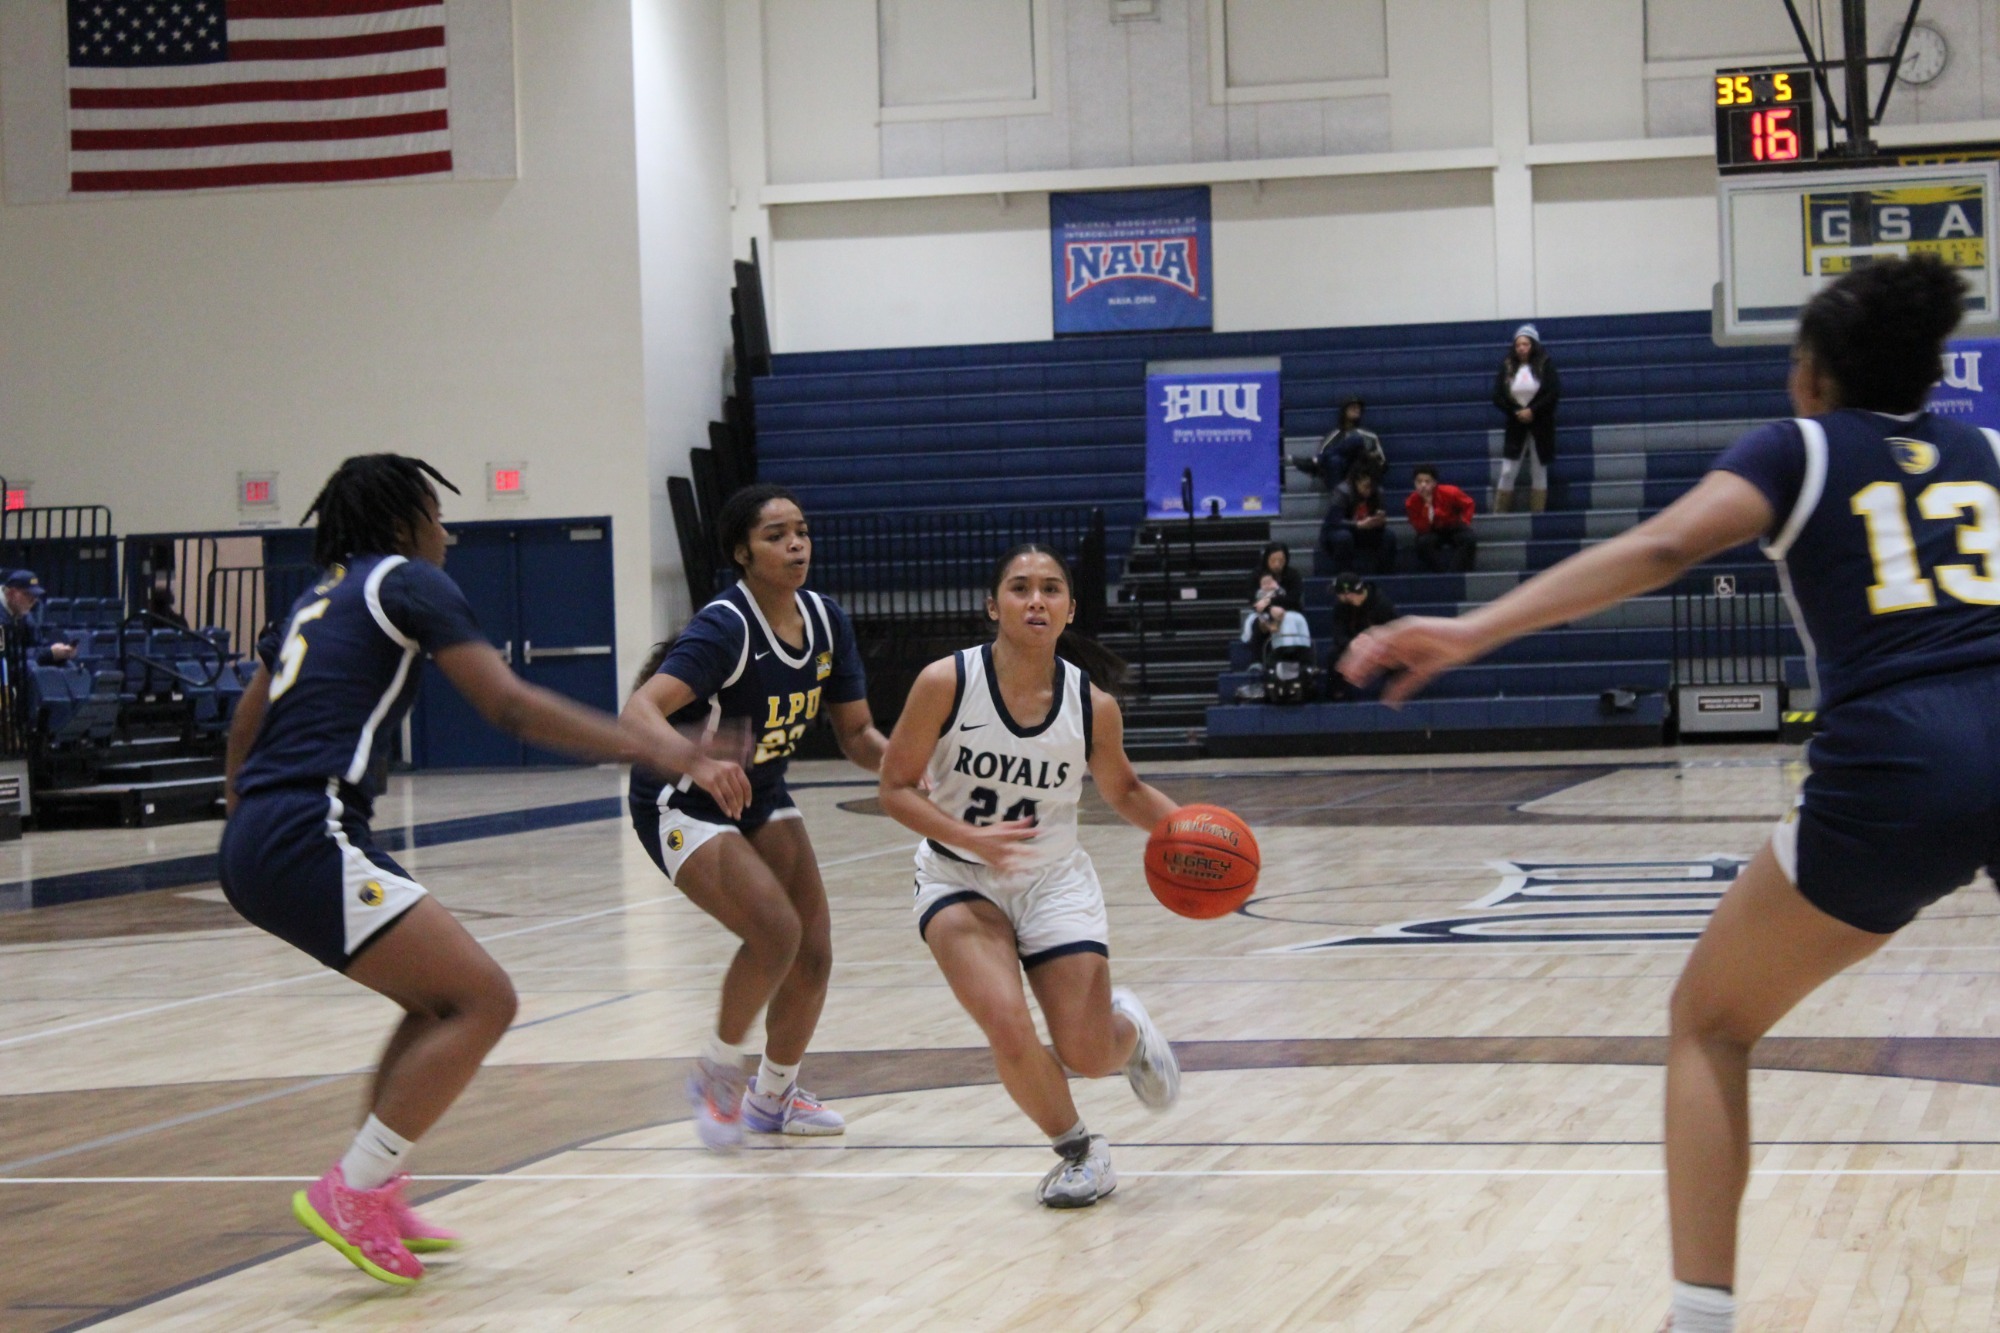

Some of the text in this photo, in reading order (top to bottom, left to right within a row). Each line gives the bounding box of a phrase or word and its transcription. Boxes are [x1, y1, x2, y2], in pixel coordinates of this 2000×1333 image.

[1716, 74, 1792, 105] 35 5
[1752, 109, 1798, 161] 16
[1067, 238, 1195, 299] NAIA
[1108, 296, 1157, 306] NAIA.ORG
[1161, 383, 1262, 424] HIU
[1850, 481, 2000, 615] 13
[764, 686, 822, 728] LPU
[953, 745, 1071, 789] ROYALS
[1163, 850, 1232, 872] LEGACY
